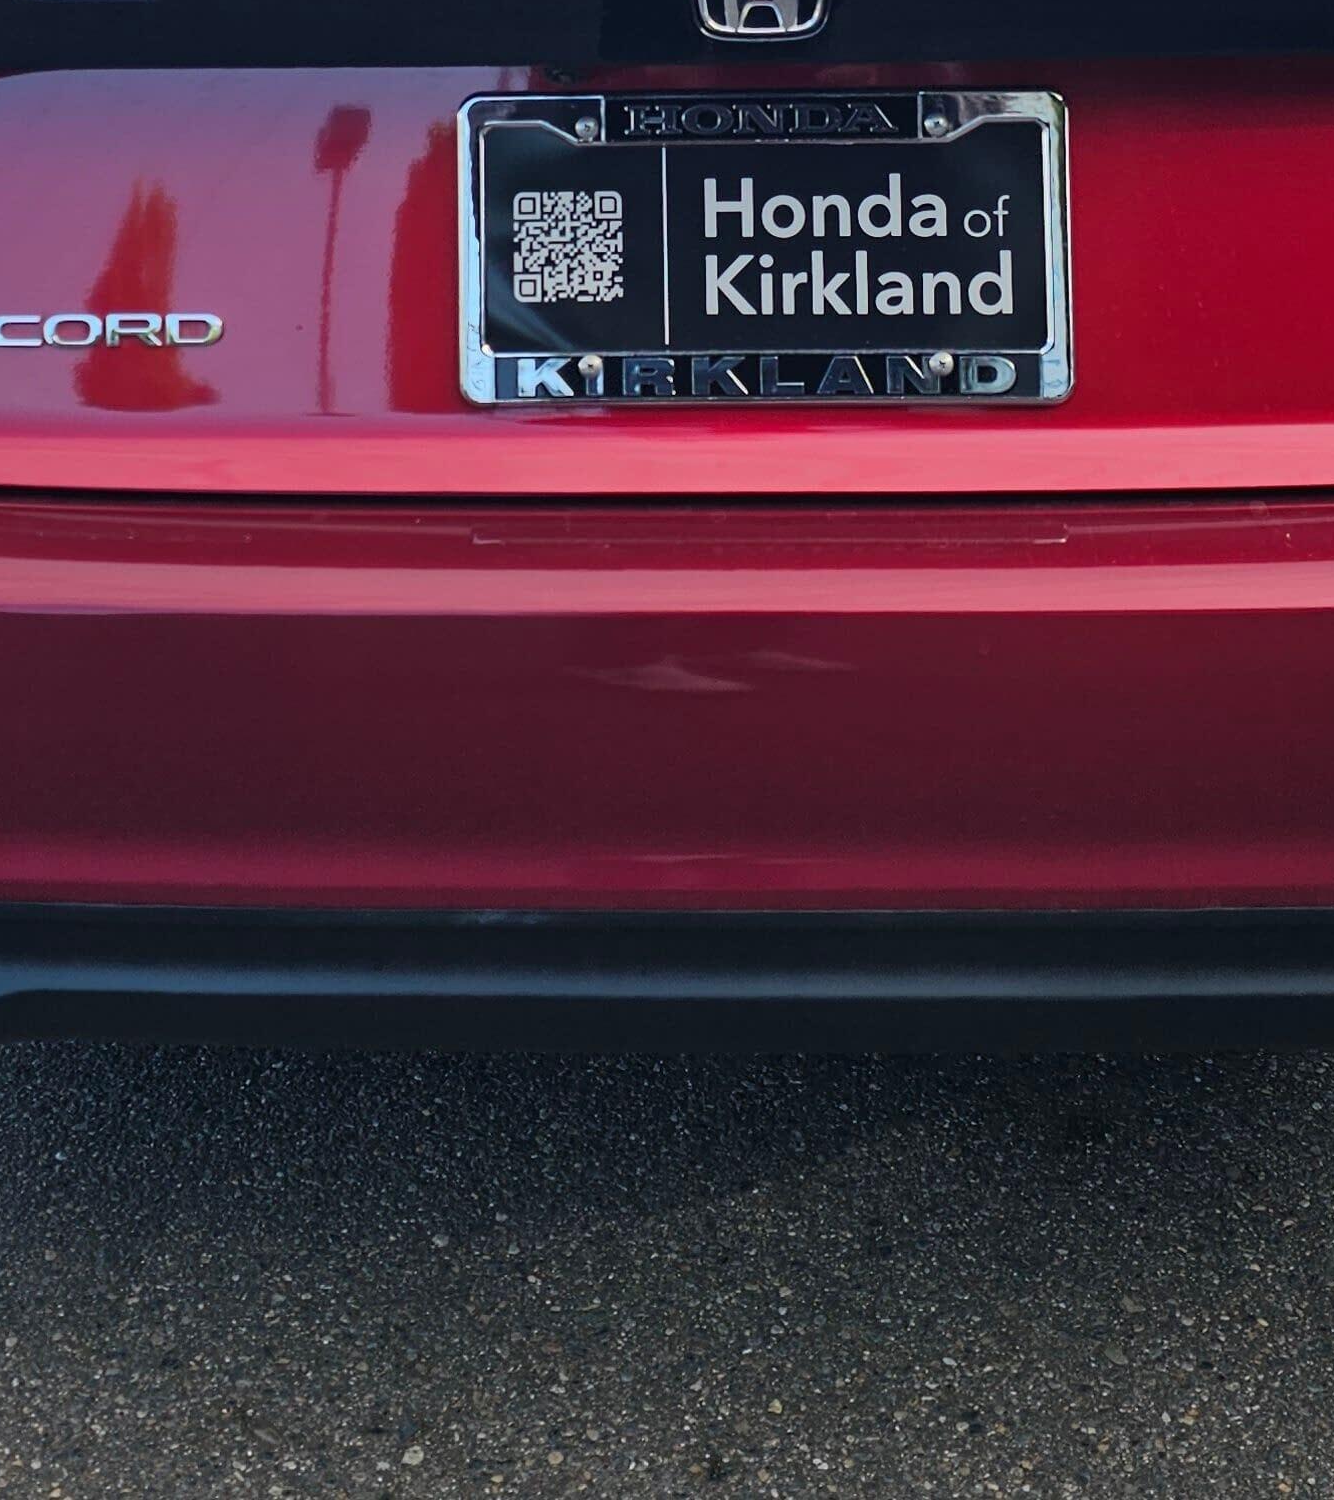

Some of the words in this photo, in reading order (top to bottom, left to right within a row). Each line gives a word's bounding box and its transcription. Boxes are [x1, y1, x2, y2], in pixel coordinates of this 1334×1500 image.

[623, 102, 899, 135] HONDA
[703, 172, 948, 238] Honda
[963, 194, 1011, 238] of
[704, 250, 1015, 316] Kirkland
[516, 356, 1018, 397] KIRKLAND
